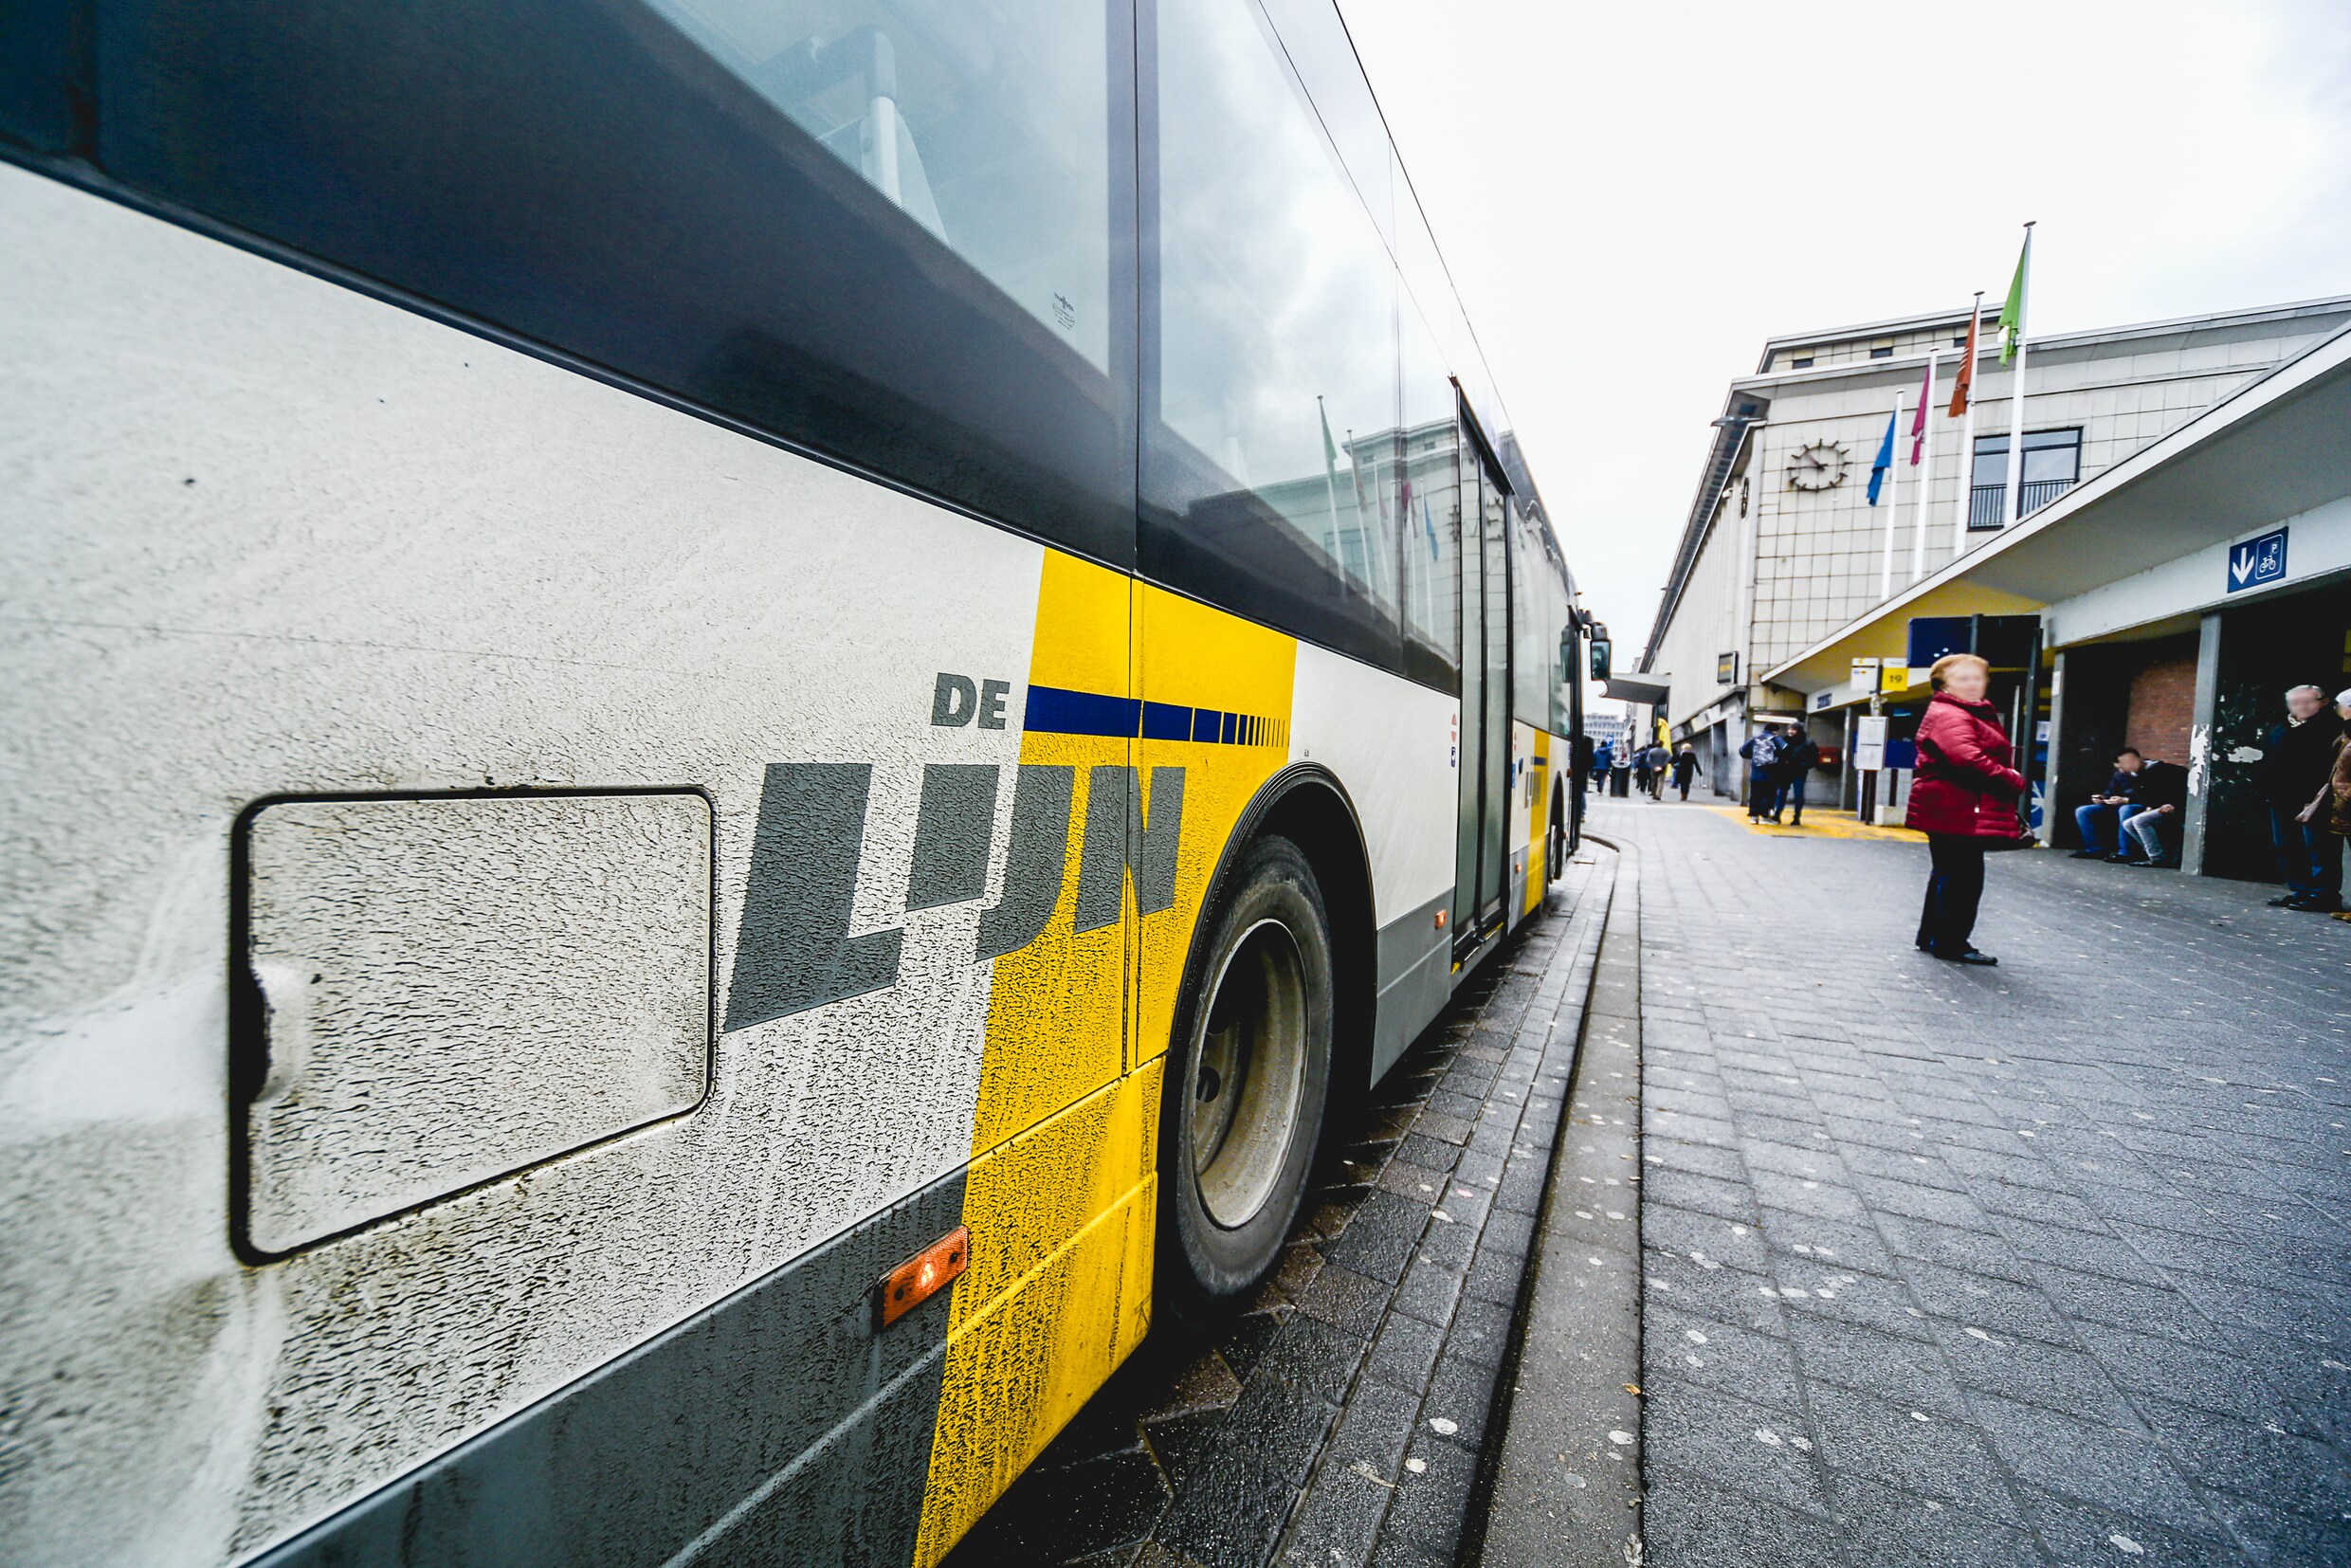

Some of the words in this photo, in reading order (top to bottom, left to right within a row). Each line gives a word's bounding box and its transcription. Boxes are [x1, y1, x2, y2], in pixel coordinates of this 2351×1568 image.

[2271, 543, 2277, 553] P
[930, 672, 1011, 730] DE
[723, 762, 1186, 1034] LIJN
